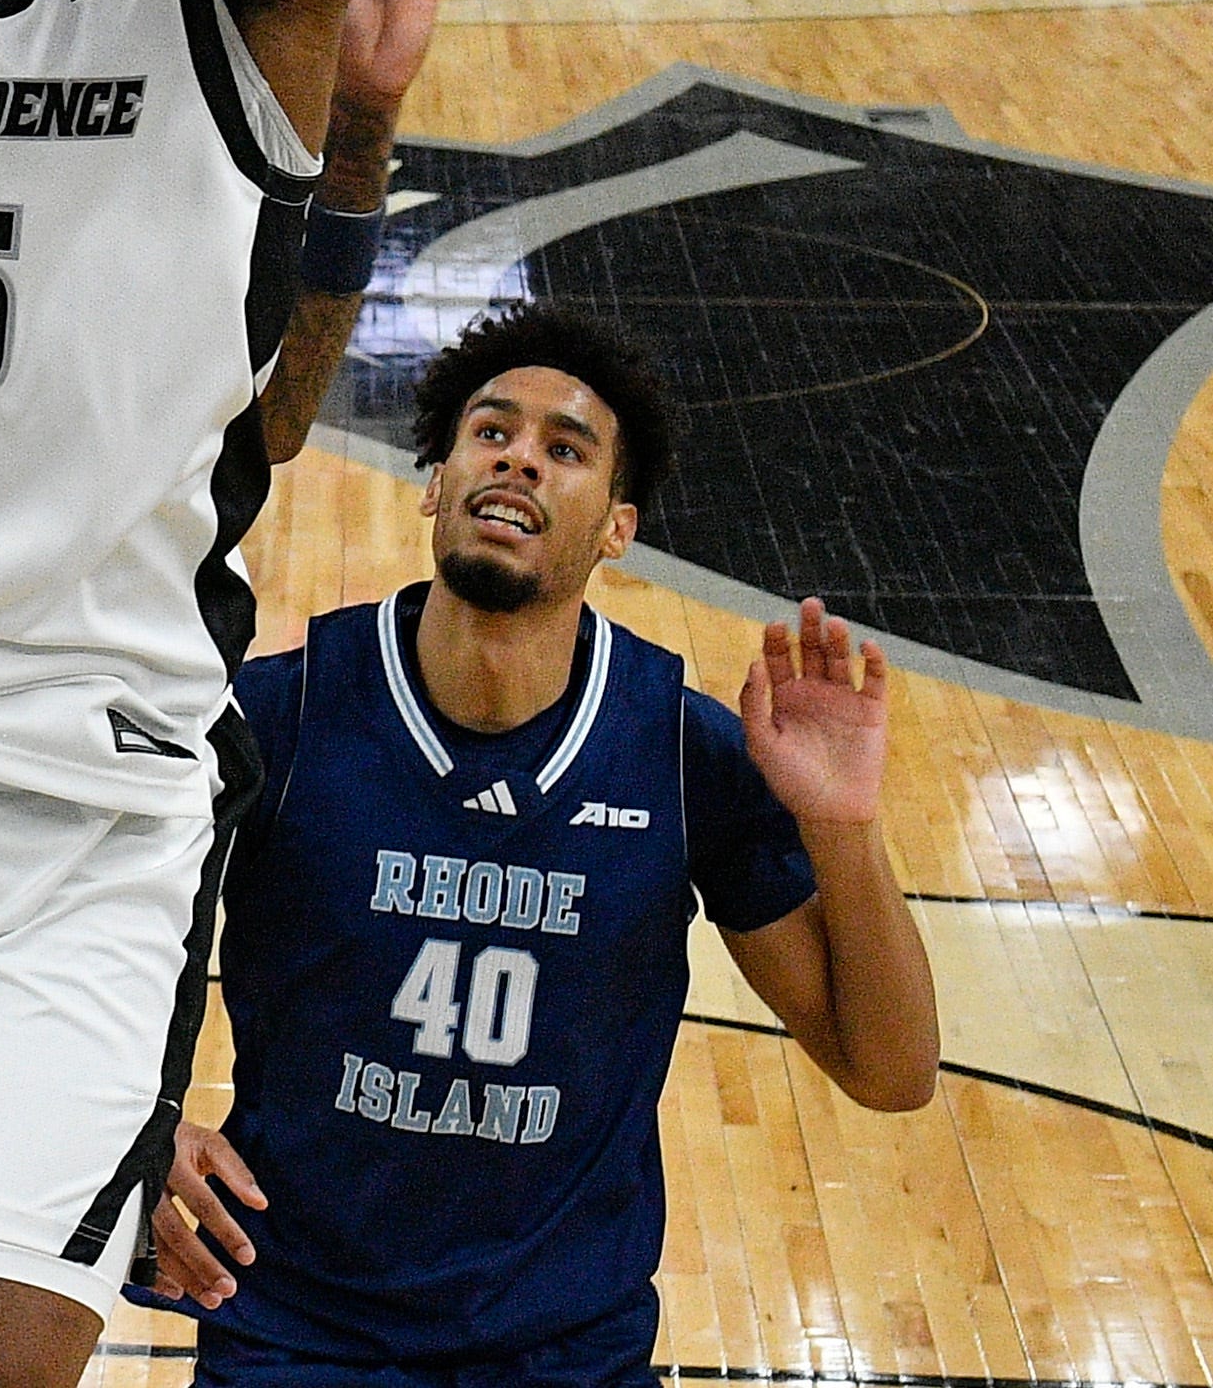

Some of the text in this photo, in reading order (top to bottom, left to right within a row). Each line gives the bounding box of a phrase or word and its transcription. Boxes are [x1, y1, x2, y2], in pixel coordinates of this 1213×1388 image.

[569, 802, 650, 829] A10
[370, 849, 586, 935] RHODE
[389, 937, 540, 1067] 40
[334, 1052, 561, 1145] ISLAND
